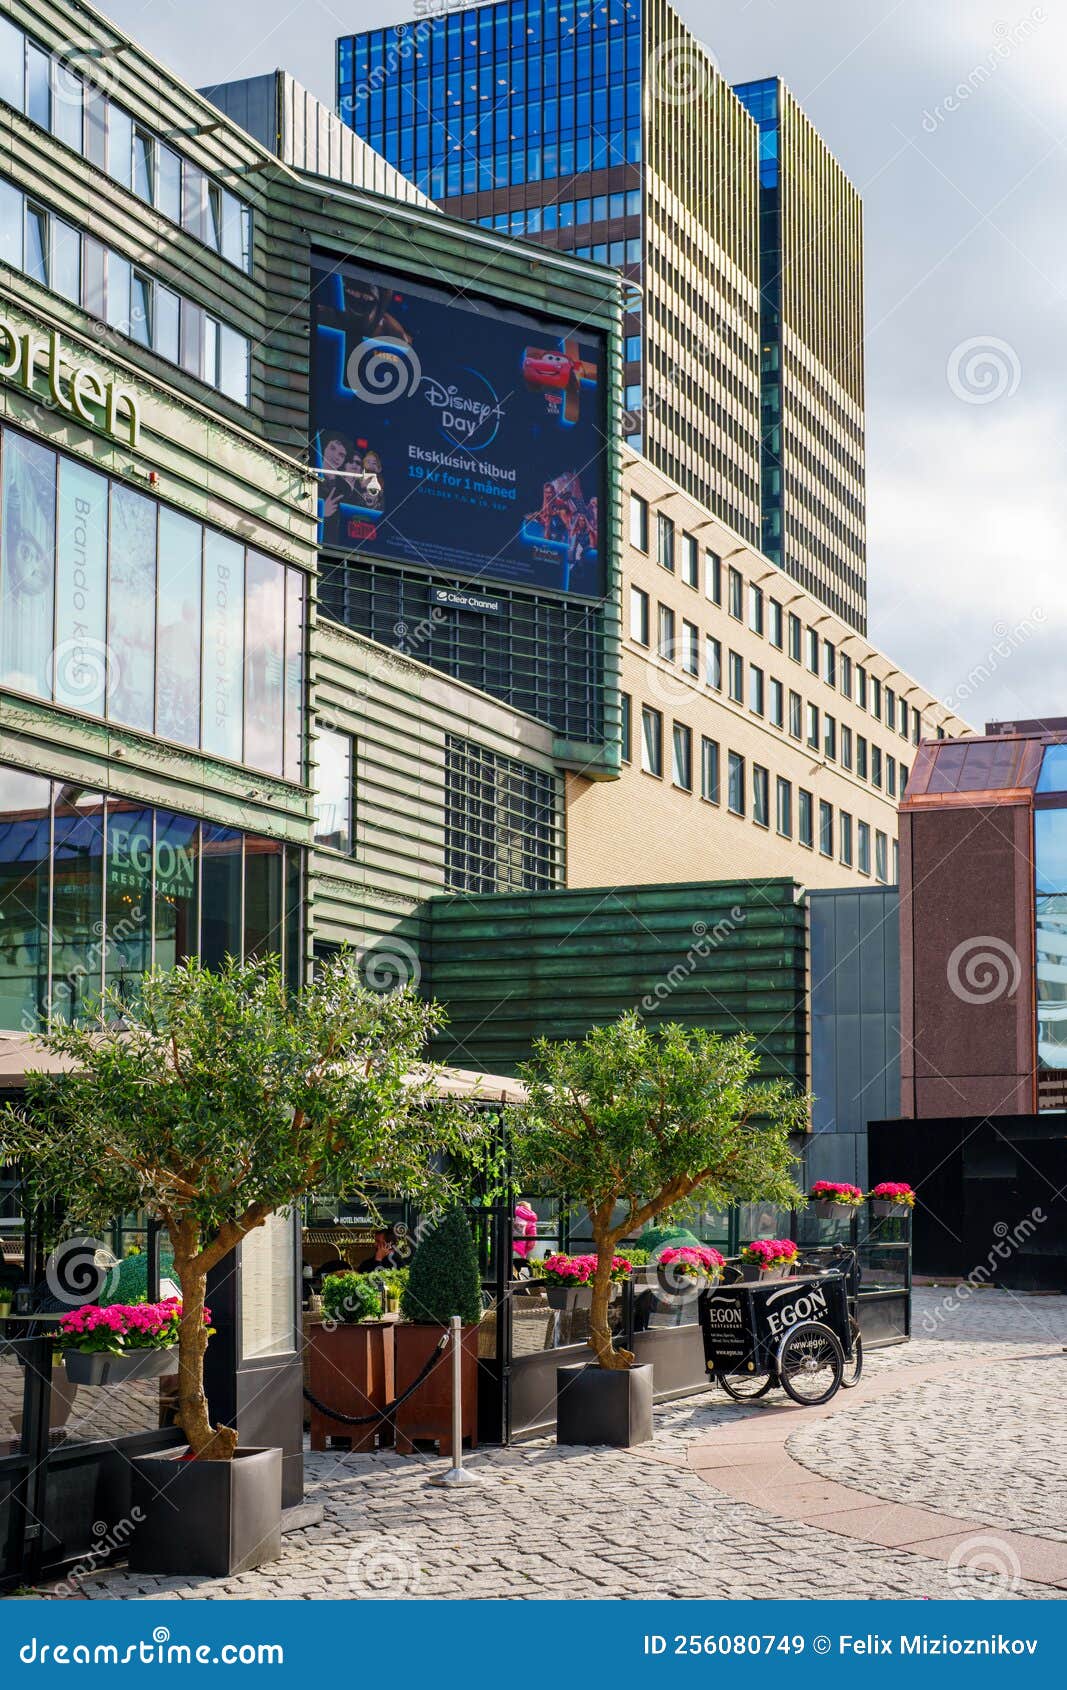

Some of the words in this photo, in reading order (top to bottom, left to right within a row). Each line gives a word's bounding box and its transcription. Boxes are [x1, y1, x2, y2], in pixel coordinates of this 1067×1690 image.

[442, 411, 475, 437] Day
[408, 445, 477, 473] Eksklusivt
[478, 461, 517, 481] tilbud
[408, 465, 423, 478] 19
[425, 468, 440, 482] kr
[442, 471, 462, 487] for
[473, 480, 517, 501] måned
[447, 593, 468, 606] Clear
[468, 597, 498, 611] Channel
[111, 827, 195, 884] EGON
[111, 870, 193, 899] RESTAURANT
[340, 1216, 354, 1224] HOTEL
[354, 1216, 376, 1225] ENTRANC
[710, 1308, 742, 1323] EGON
[766, 1287, 827, 1336] EGON
